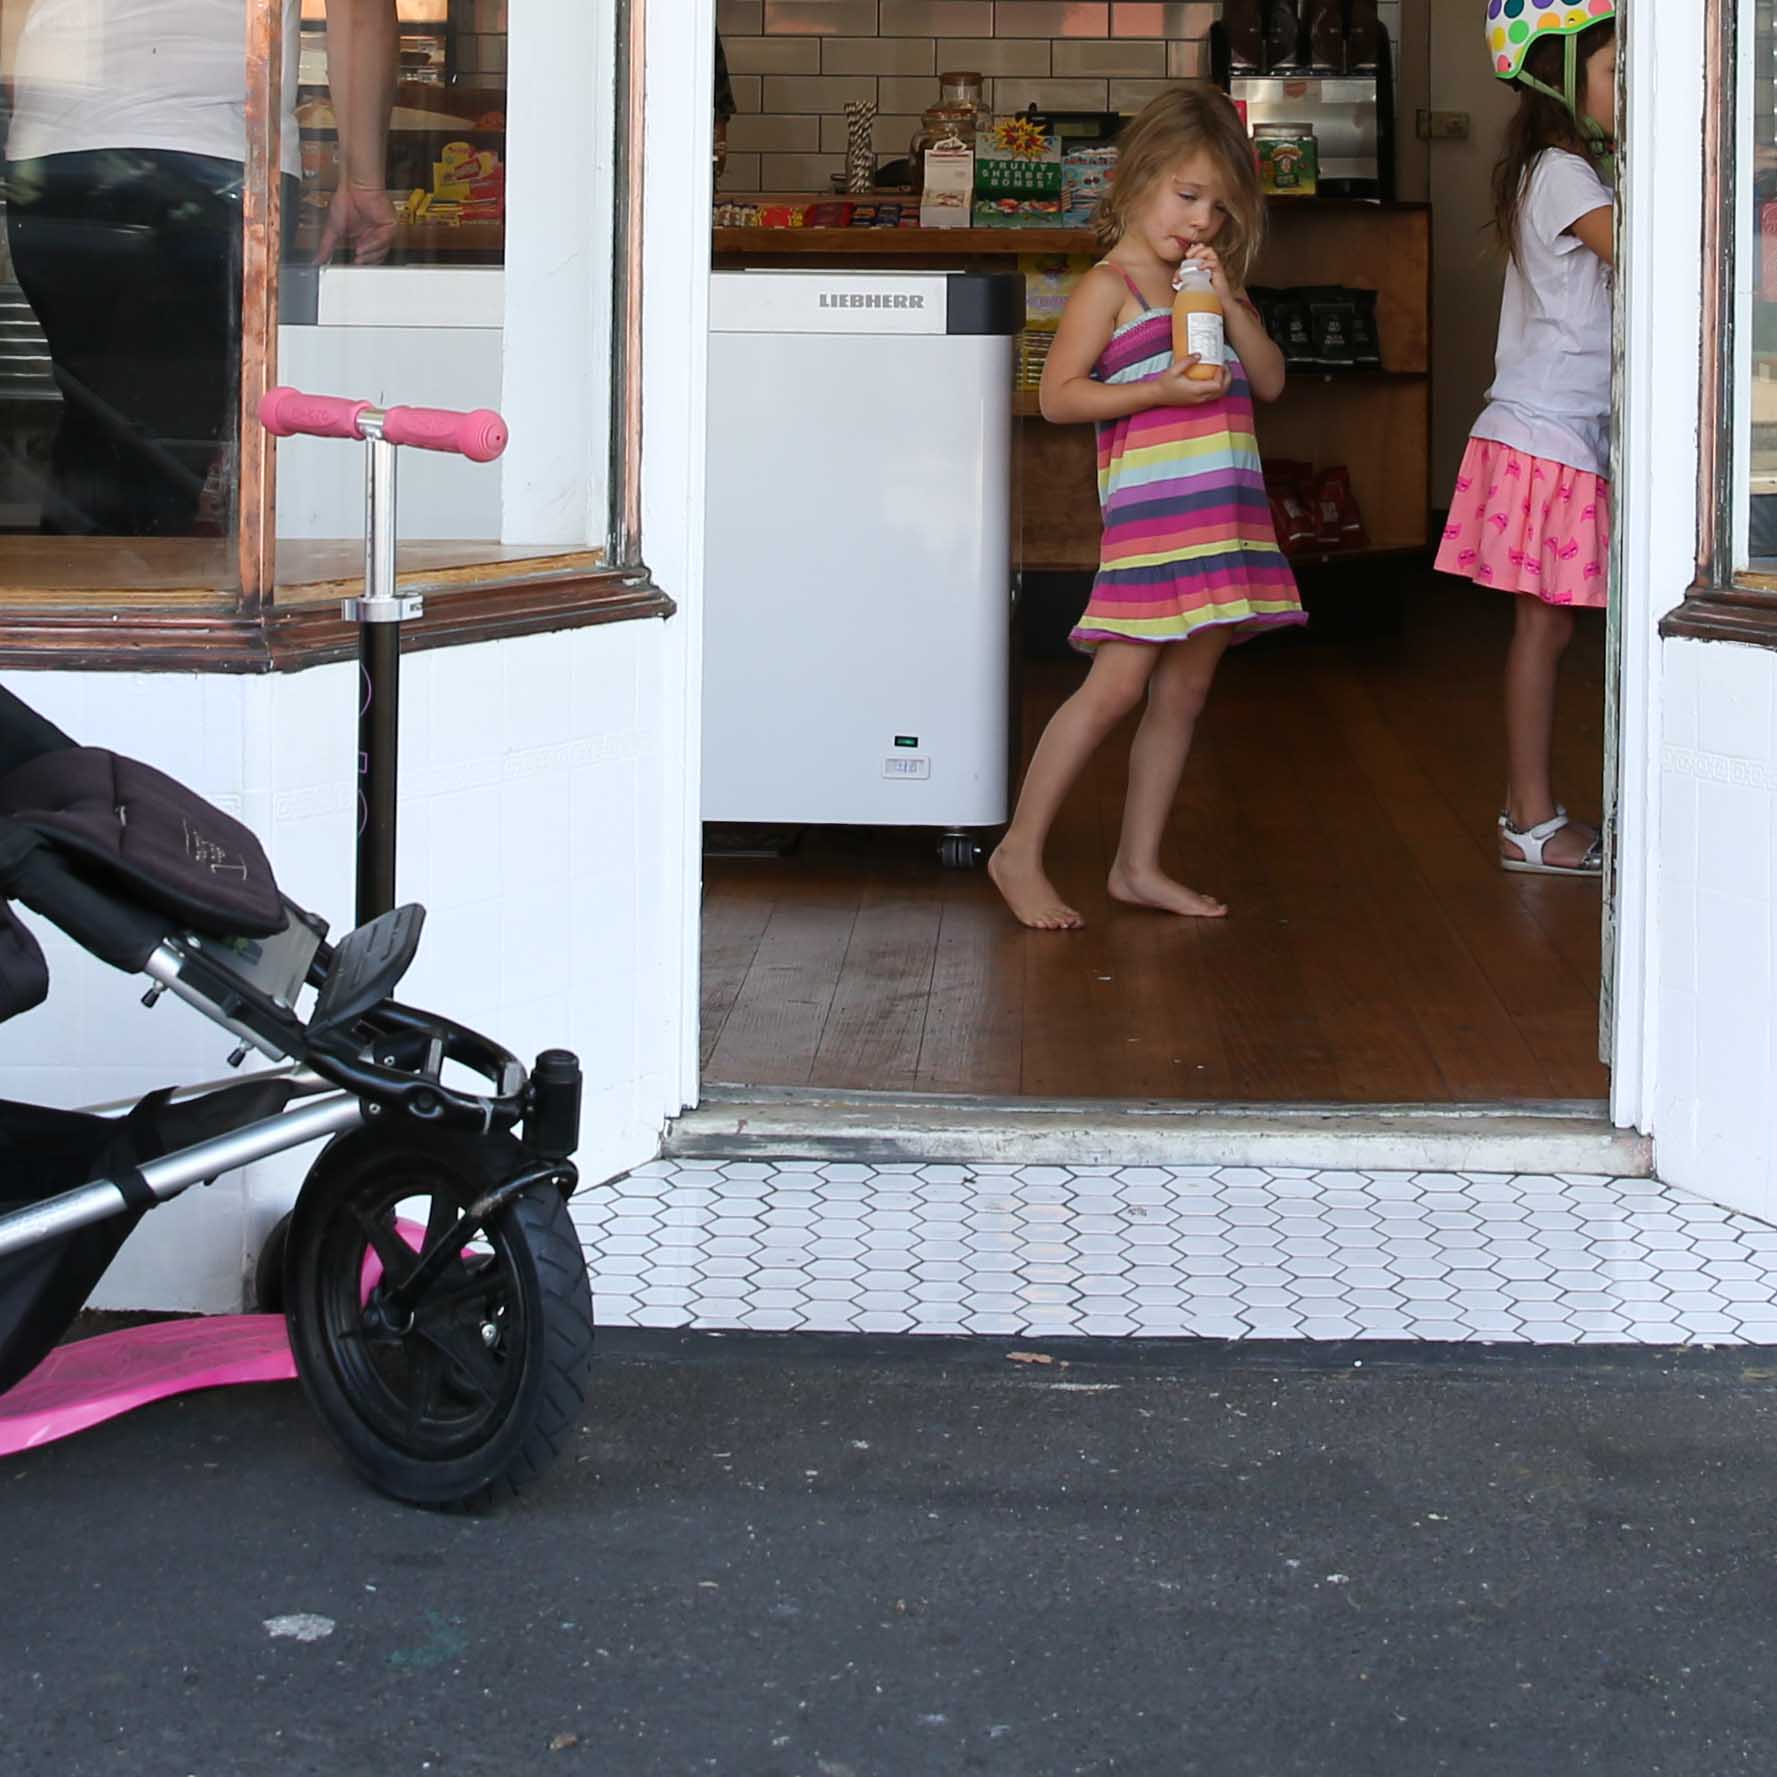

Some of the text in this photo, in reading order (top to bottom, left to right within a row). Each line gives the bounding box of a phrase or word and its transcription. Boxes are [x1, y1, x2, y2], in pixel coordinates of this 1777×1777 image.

[988, 161, 1049, 171] FRUITY
[981, 169, 1055, 180] SHERBET
[990, 178, 1046, 189] BOMBS
[818, 293, 925, 309] LIEBHERR
